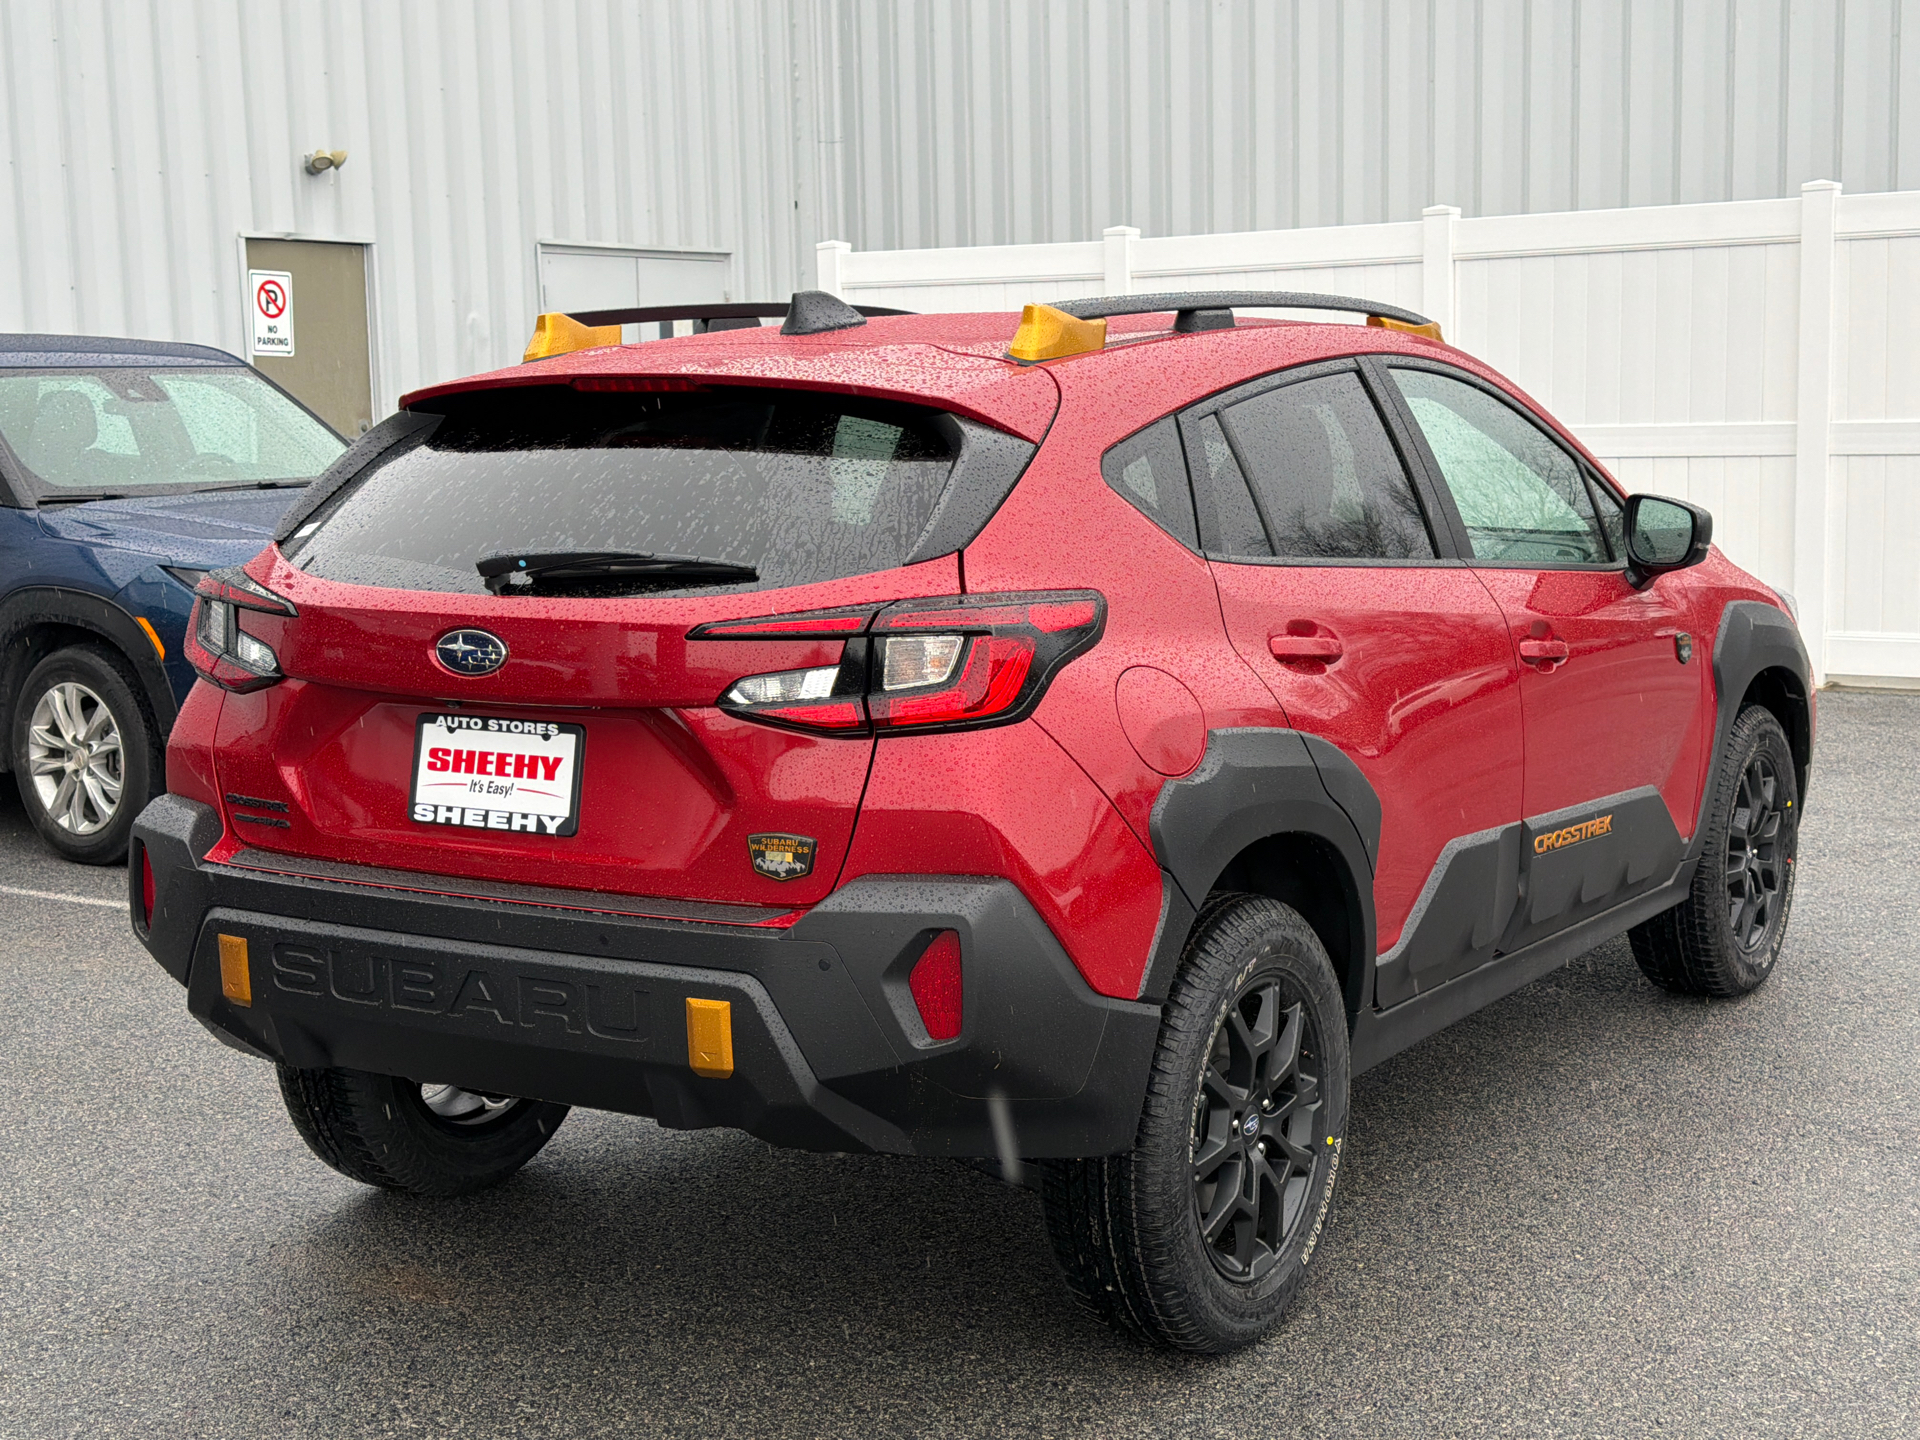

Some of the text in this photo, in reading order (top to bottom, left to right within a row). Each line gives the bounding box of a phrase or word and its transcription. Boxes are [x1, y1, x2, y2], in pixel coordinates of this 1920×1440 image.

[267, 325, 278, 334] NO
[257, 337, 289, 346] PARKING
[435, 715, 559, 736] AUTO STORES
[427, 747, 564, 781] SHEEHY
[469, 779, 514, 799] It's Easy!
[225, 792, 290, 813] CROSSTREK
[413, 804, 566, 834] SHEEHY
[761, 837, 799, 846] SUBARU
[1533, 814, 1613, 854] CROSSTREK
[751, 843, 809, 853] WILDERNESS
[271, 942, 651, 1042] SUBARU
[1300, 1137, 1342, 1265] YOKOHAMA
